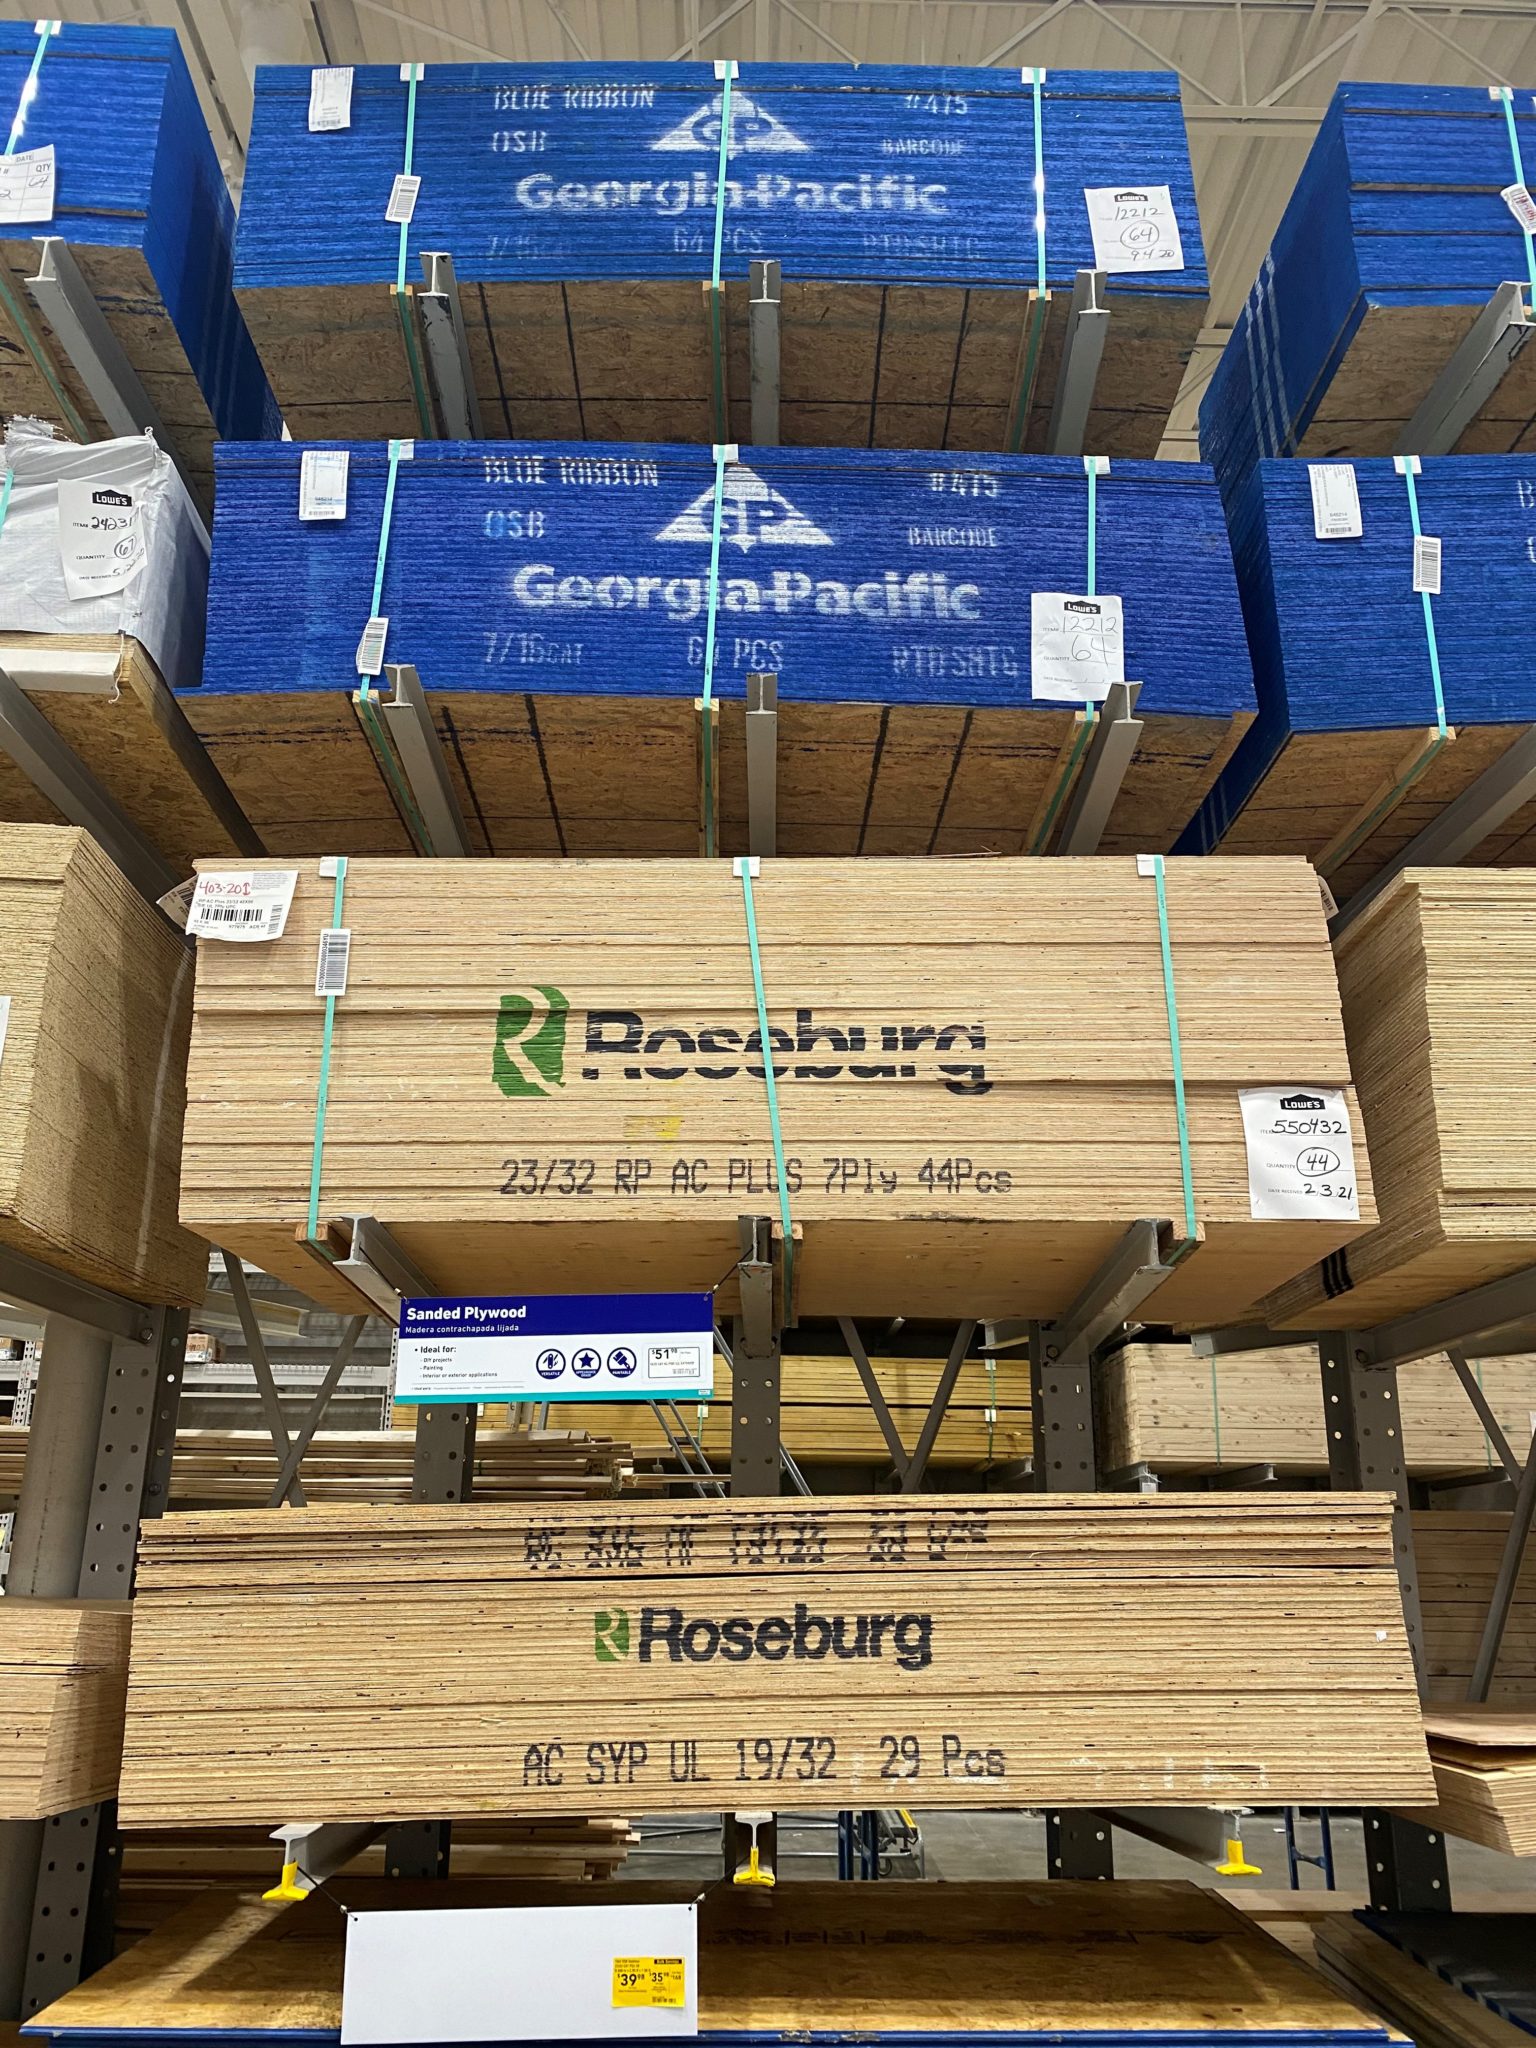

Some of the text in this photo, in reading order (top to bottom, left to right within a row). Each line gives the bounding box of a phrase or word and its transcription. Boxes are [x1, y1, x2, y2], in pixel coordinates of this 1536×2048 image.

[1129, 226, 1153, 243] 64
[482, 454, 658, 487] BLUE RIBBON
[96, 494, 128, 506] LOWE'S
[484, 511, 545, 539] OSB
[1067, 603, 1098, 613] LOWE'S
[734, 637, 785, 671] PCS
[1071, 634, 1117, 668] 64
[582, 1010, 993, 1095] Roseburg
[1284, 1101, 1321, 1109] LOWE'S
[1307, 1153, 1329, 1171] 44
[500, 1158, 596, 1195] 23/32
[614, 1158, 652, 1194] RP
[672, 1157, 708, 1194] AC
[728, 1158, 803, 1195] PLUS
[407, 1305, 527, 1321] Sanded Plywood
[437, 1324, 495, 1333] contrachapada
[497, 1324, 520, 1333] lijada
[420, 1345, 457, 1354] Ideal for:
[638, 1603, 933, 1671] Roseburg
[523, 1735, 1006, 1786] AC SYP UL 19/32 29 Pcs
